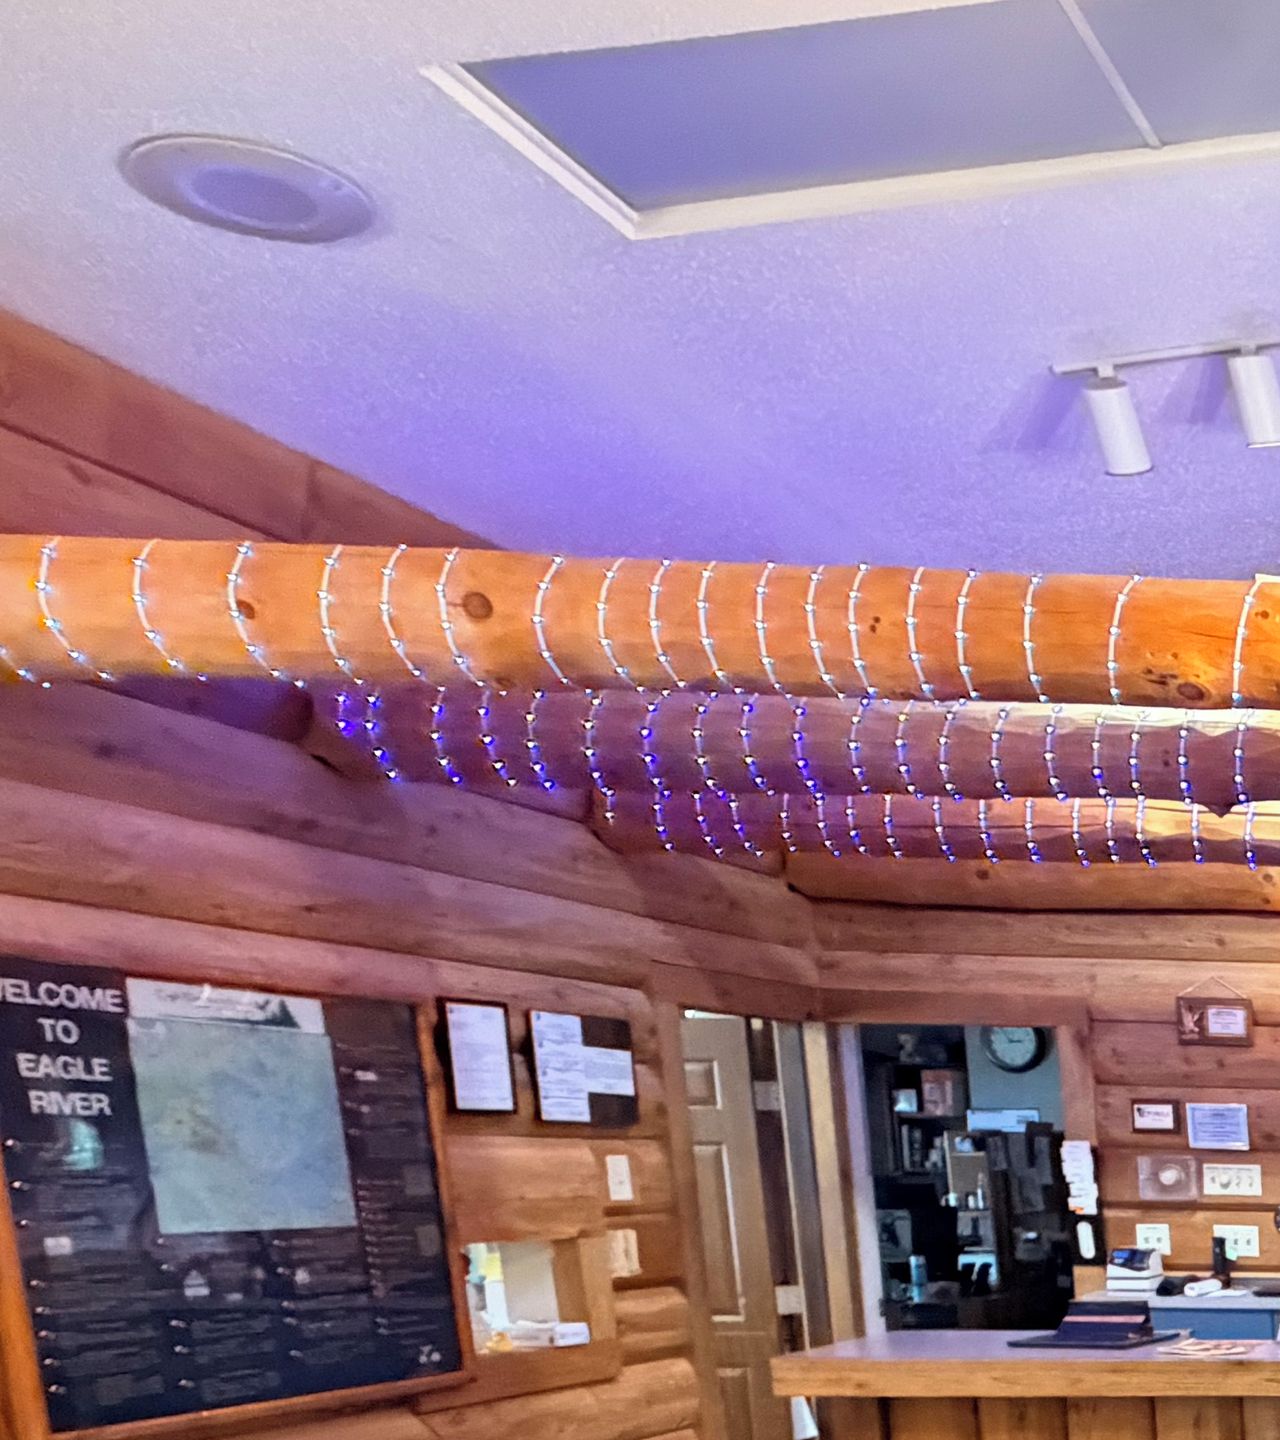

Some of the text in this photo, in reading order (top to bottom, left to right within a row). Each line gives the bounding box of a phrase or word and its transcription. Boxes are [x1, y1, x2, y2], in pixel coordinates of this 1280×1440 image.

[37, 1017, 80, 1044] TO
[15, 1053, 114, 1082] EAGLE
[27, 1089, 113, 1116] RIVER
